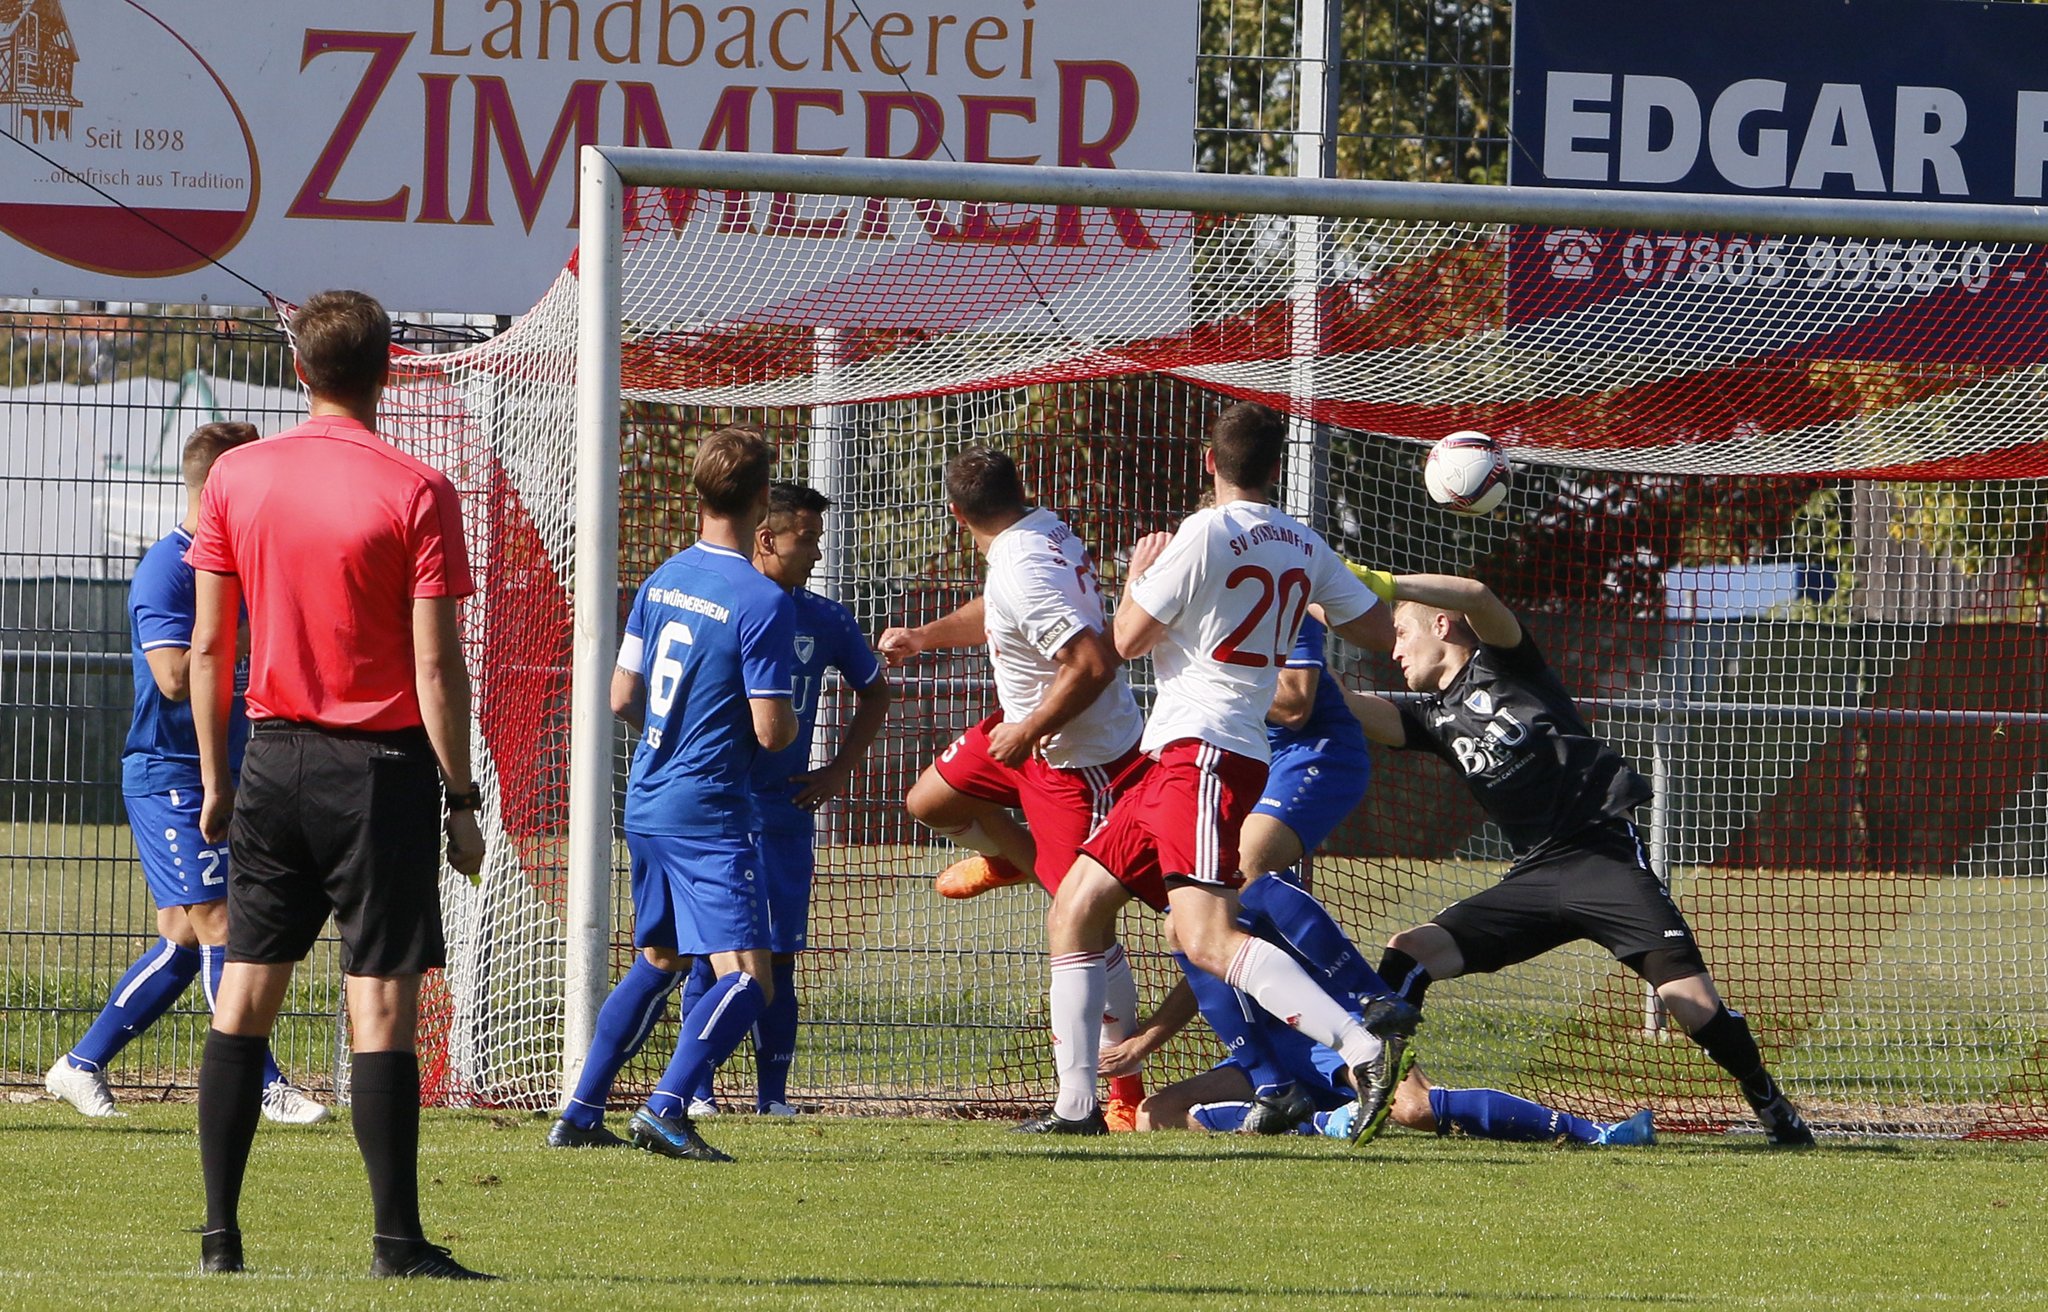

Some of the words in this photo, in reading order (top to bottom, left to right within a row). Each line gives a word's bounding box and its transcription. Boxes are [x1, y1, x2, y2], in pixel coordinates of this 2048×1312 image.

[85, 126, 122, 150] Seit
[135, 128, 185, 151] 1898
[285, 28, 1162, 250] ZIMMERER
[1543, 71, 1970, 196] EDGAR
[136, 173, 164, 187] aus
[170, 170, 245, 190] Tradition
[1622, 234, 1786, 286] 07805
[1806, 240, 1991, 293] 9958-0
[1229, 534, 1249, 556] SV
[1211, 564, 1312, 668] 20
[650, 620, 693, 718] 6
[1324, 951, 1351, 978] JAKO
